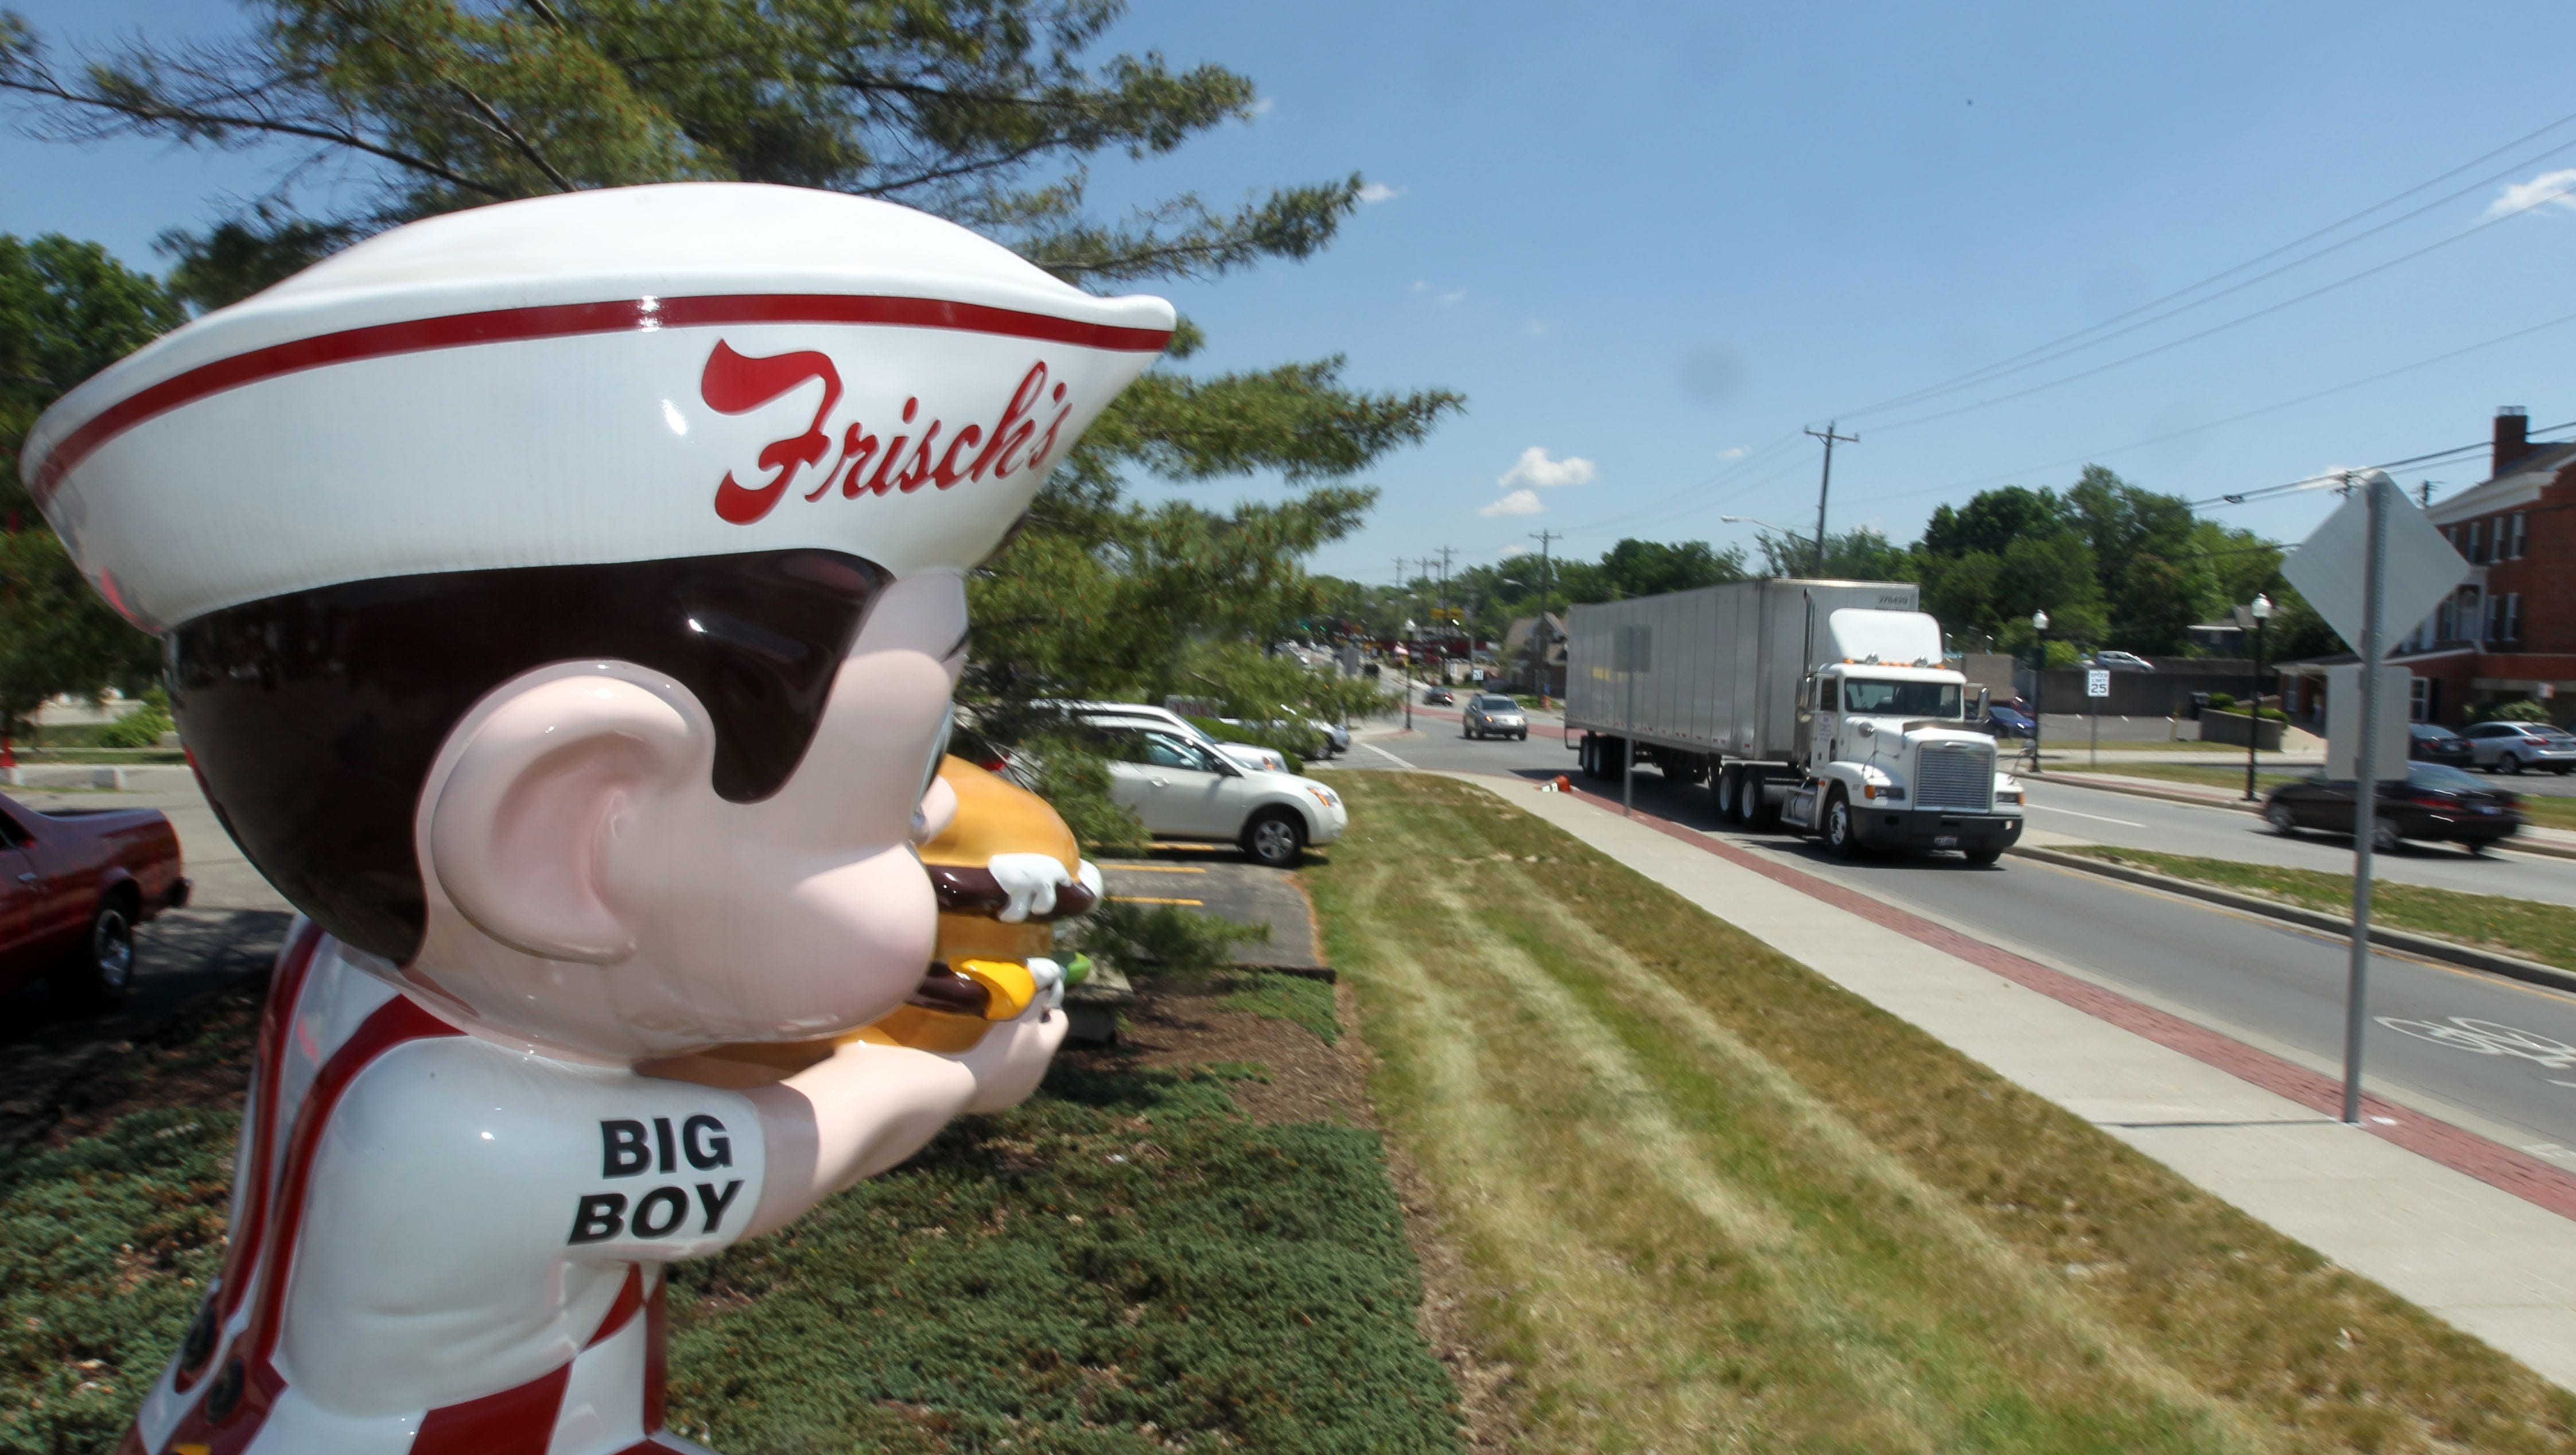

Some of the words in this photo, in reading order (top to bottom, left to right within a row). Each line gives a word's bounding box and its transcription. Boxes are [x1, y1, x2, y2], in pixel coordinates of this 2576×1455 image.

[701, 337, 1073, 526] Frisch's
[2091, 683, 2107, 693] 25
[600, 1114, 734, 1180] BIG
[566, 1179, 745, 1246] BOY
